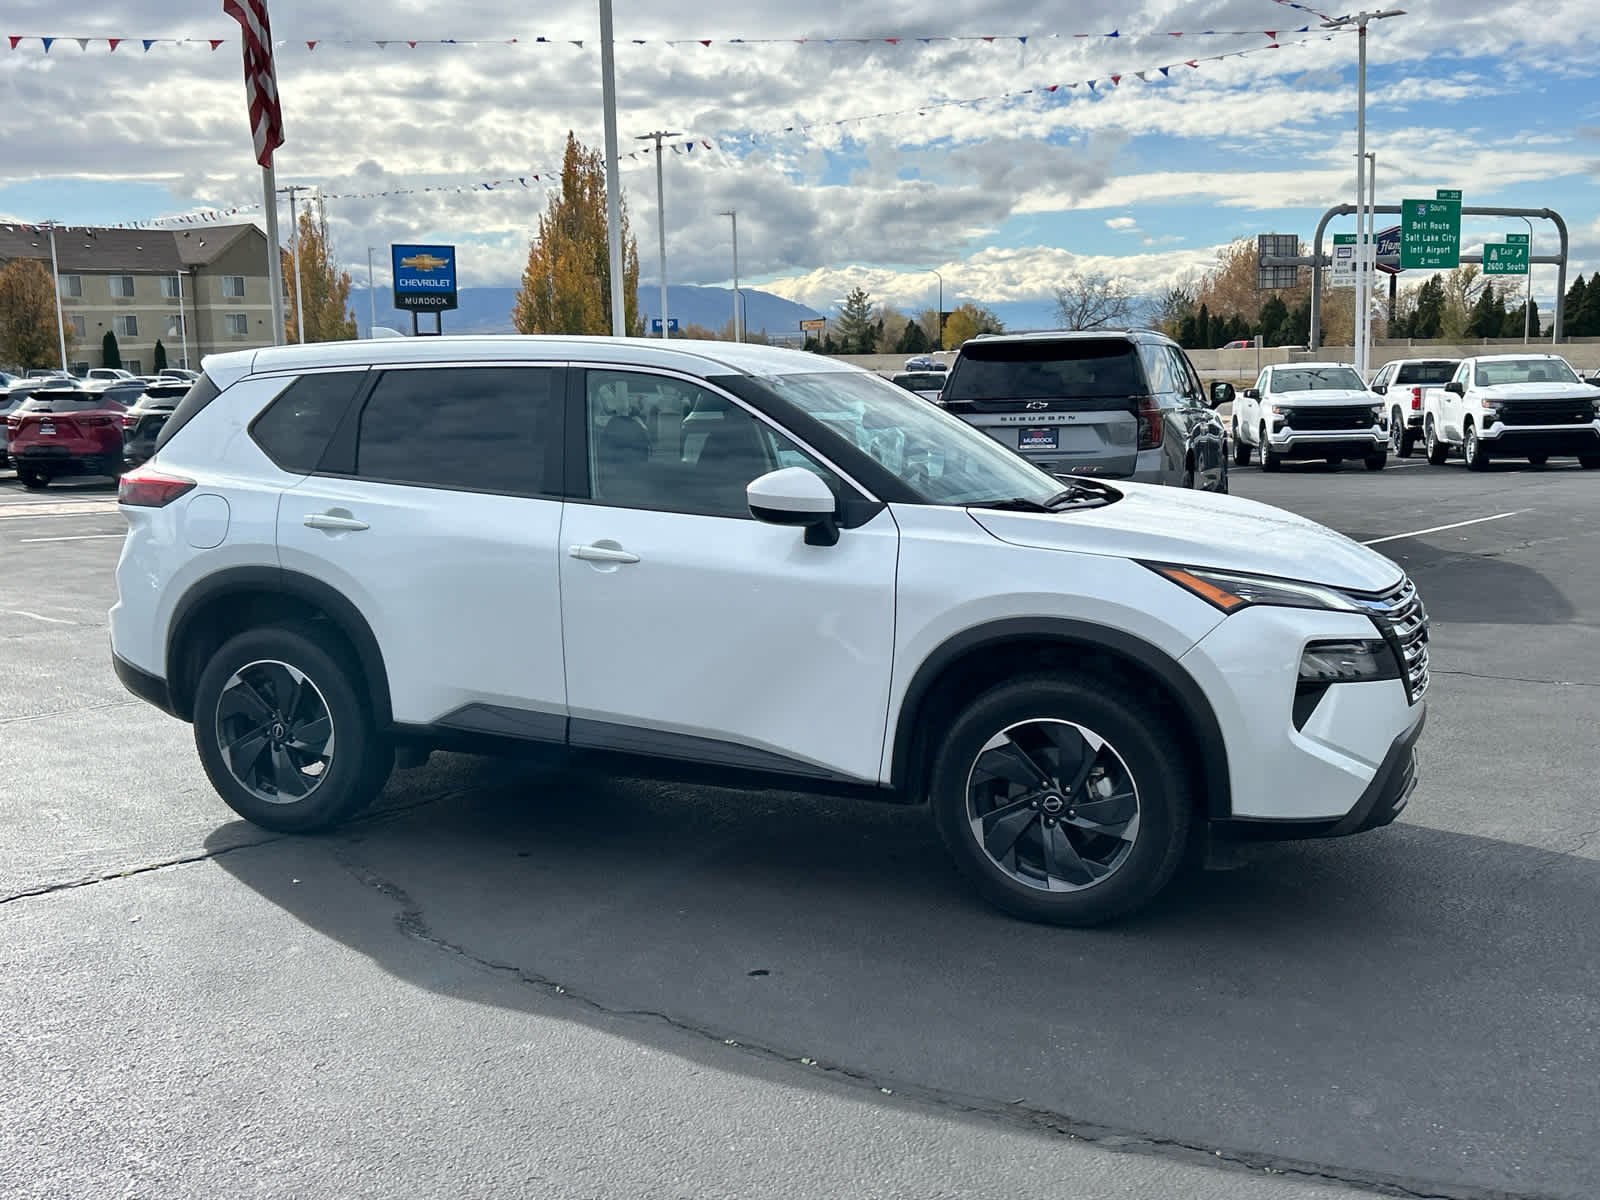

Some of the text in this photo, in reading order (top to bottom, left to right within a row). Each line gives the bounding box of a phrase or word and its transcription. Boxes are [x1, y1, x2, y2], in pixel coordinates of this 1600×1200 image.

[1412, 221, 1450, 230] Belt Route
[1405, 233, 1457, 243] Salt Lake City
[1410, 246, 1423, 254] Intl
[1426, 246, 1451, 255] Airport
[1420, 257, 1425, 265] 2
[1487, 262, 1526, 271] 2600 South
[399, 278, 451, 287] CHEVROLET
[404, 297, 448, 305] MURDOCK
